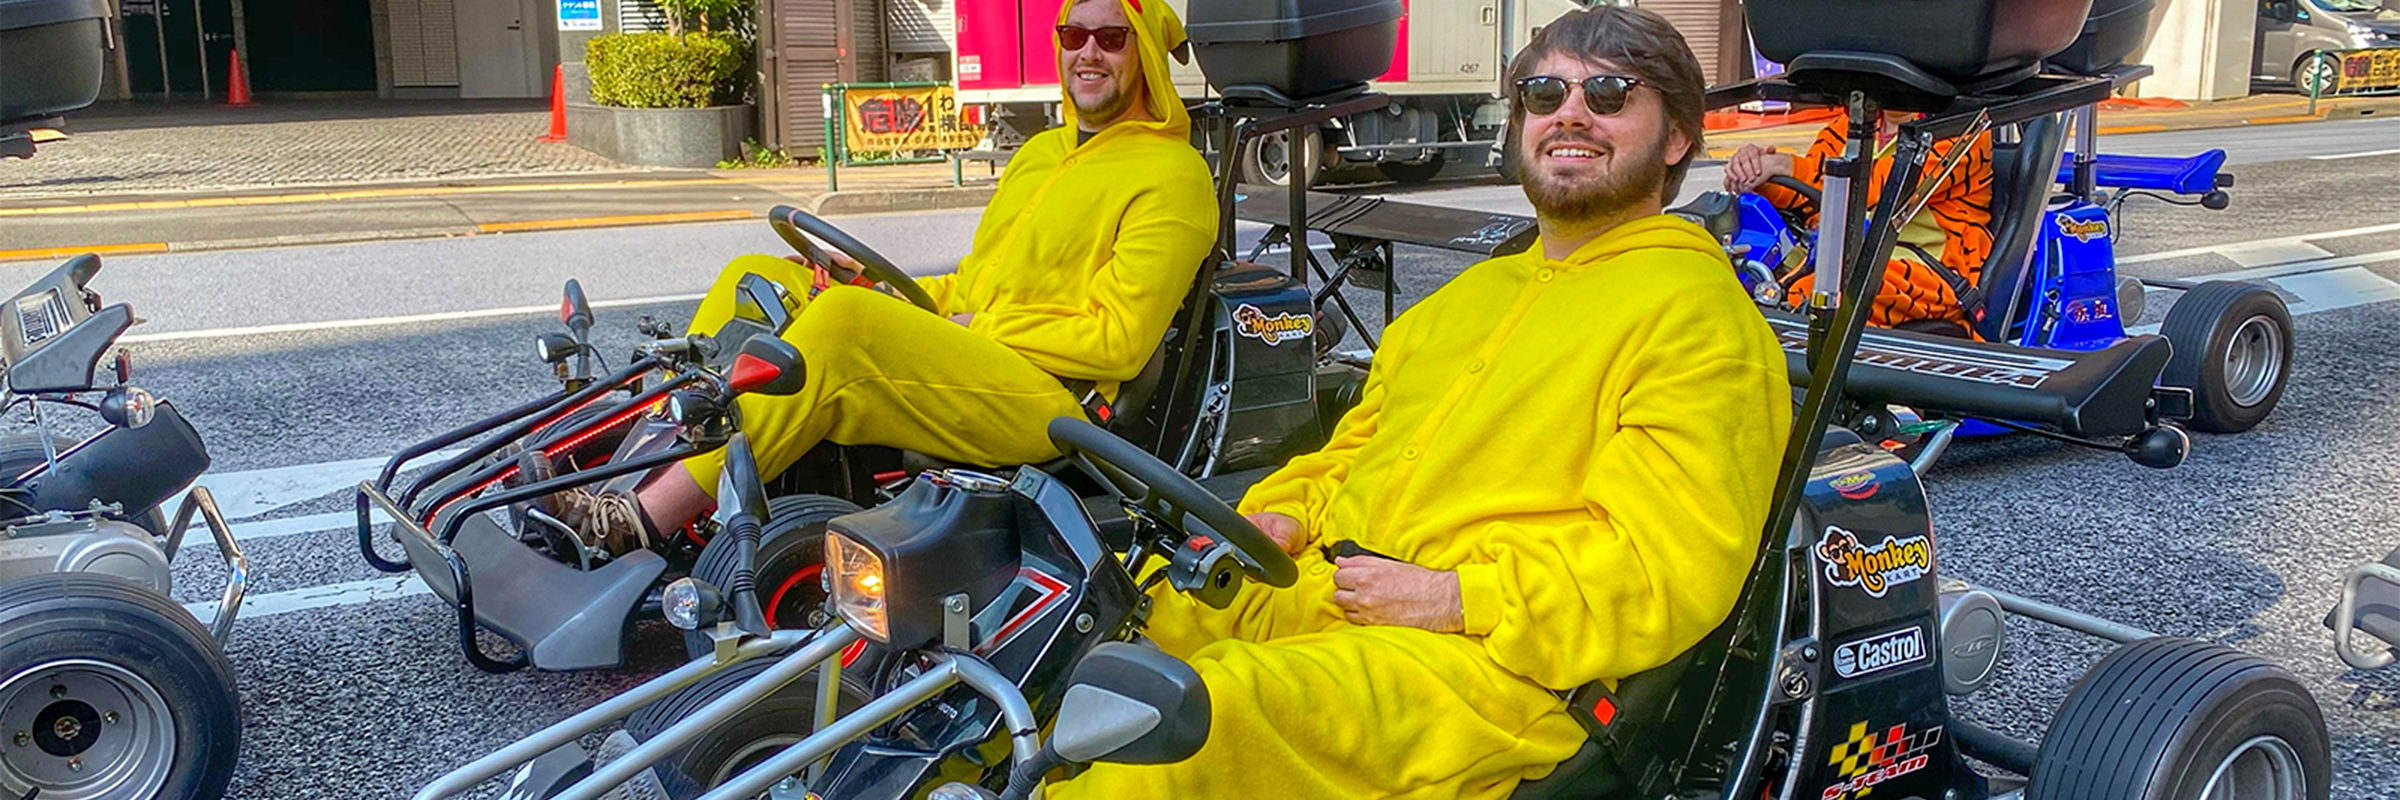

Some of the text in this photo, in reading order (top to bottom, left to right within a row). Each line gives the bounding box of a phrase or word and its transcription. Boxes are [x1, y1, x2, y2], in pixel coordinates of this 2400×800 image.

[1251, 315, 1311, 343] Monkey
[1844, 539, 1929, 592] Monkey
[1887, 568, 1918, 583] KART
[1858, 630, 1920, 671] Castrol
